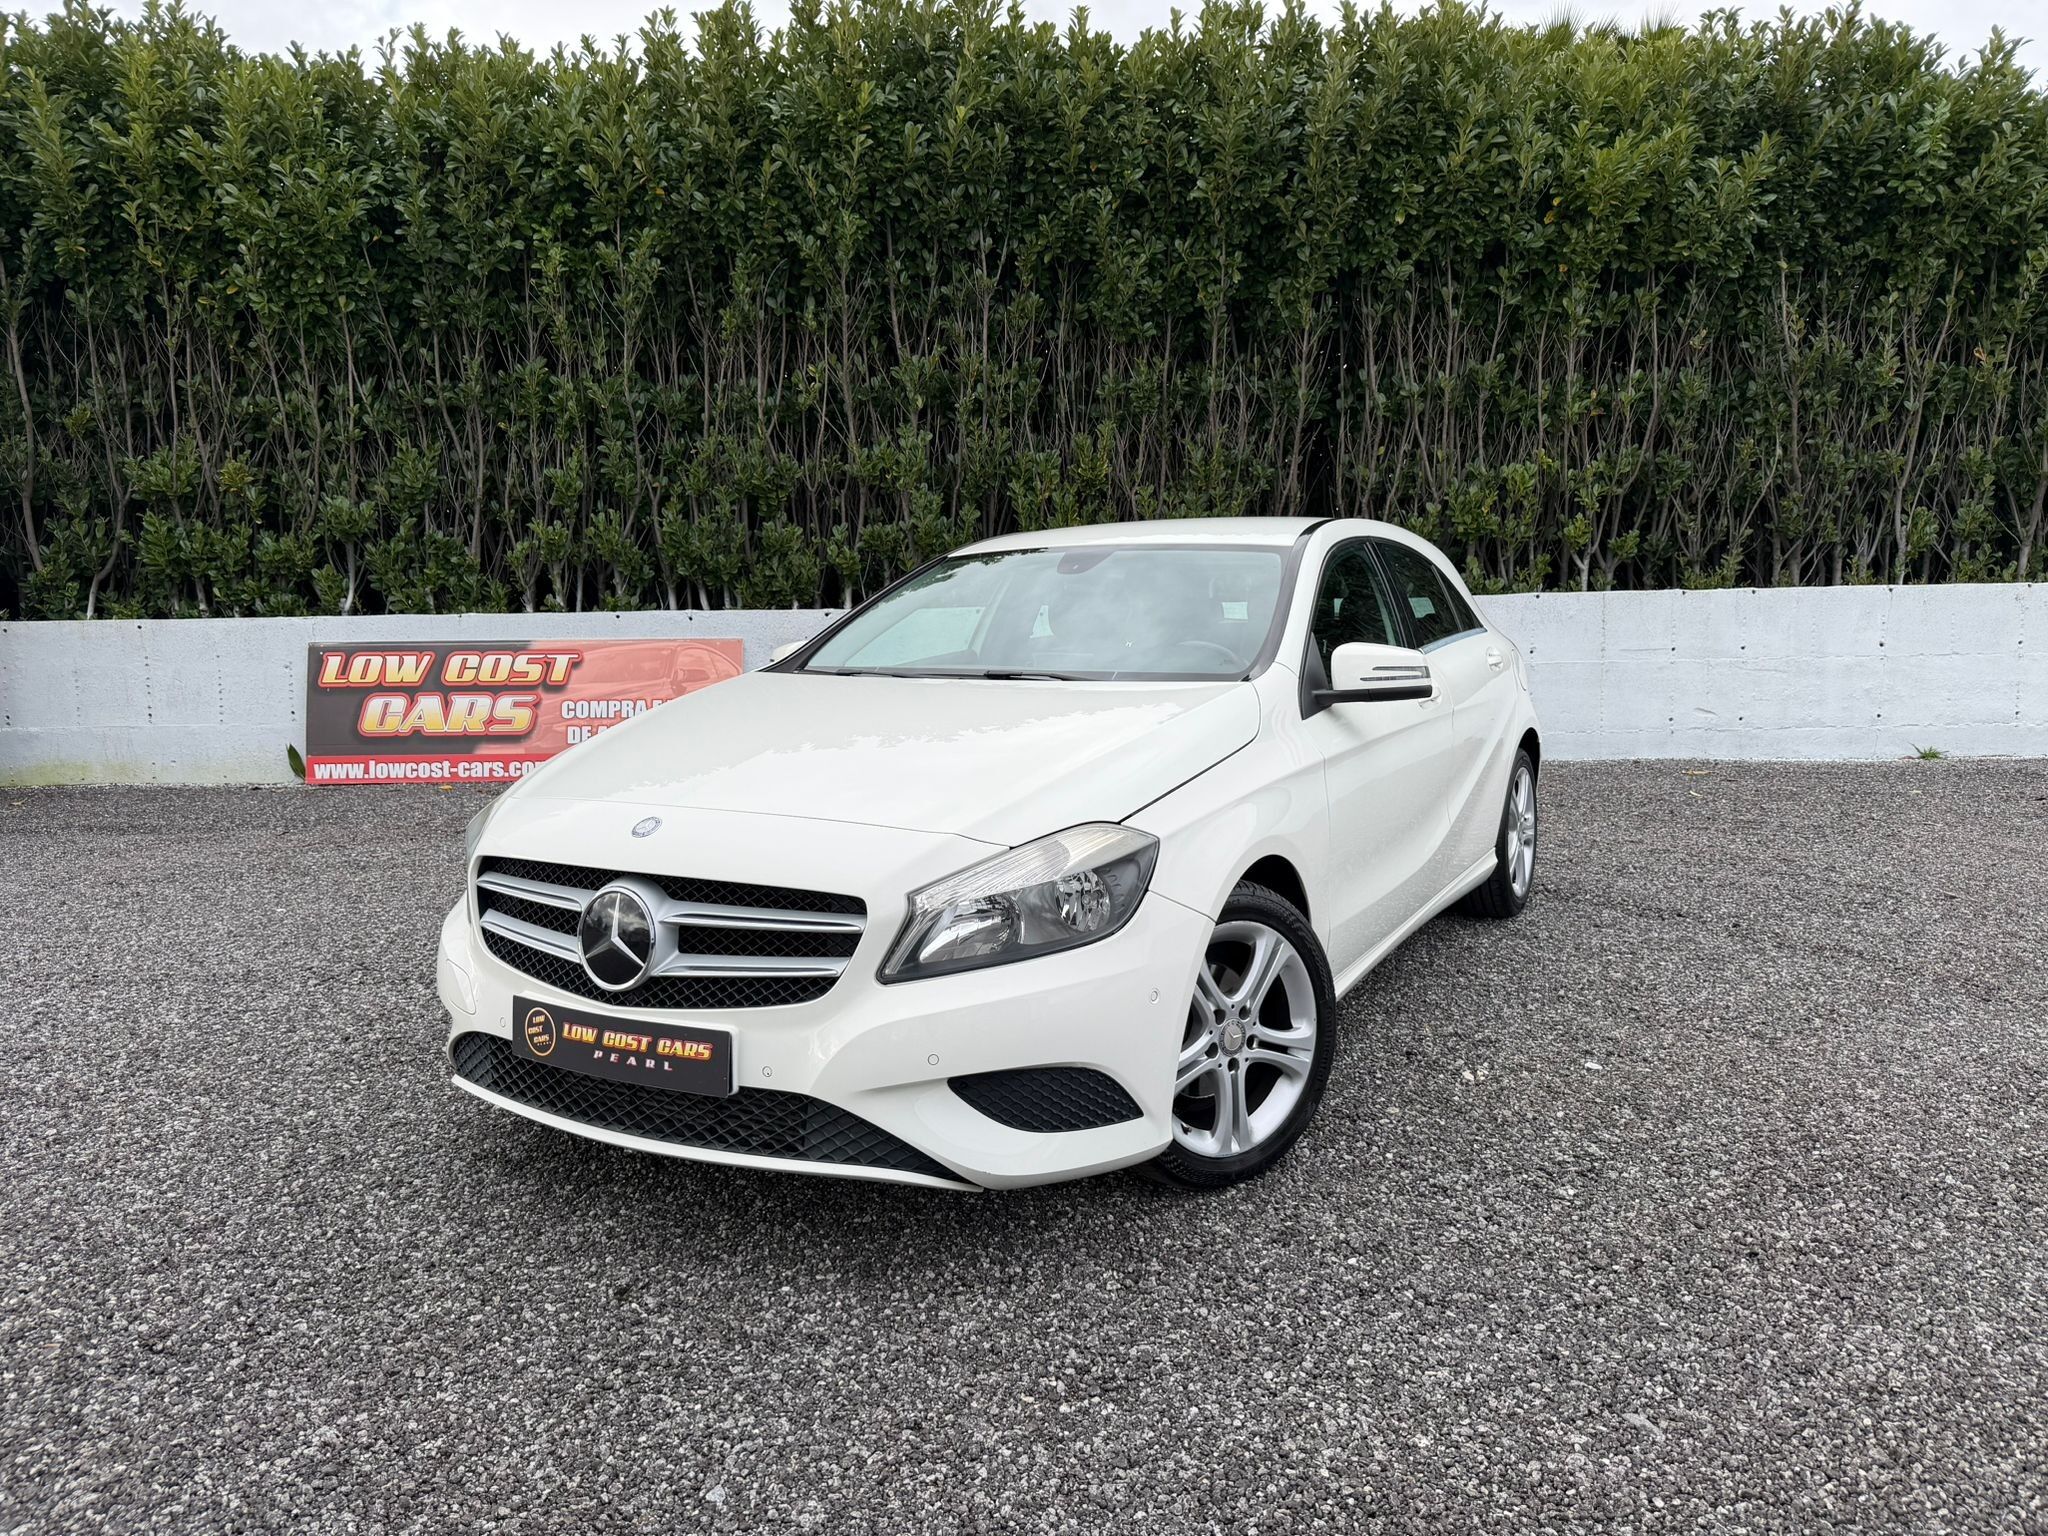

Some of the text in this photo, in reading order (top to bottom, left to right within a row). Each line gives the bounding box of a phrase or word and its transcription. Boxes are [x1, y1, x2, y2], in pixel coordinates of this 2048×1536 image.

[319, 651, 581, 686] LOW COST
[358, 692, 540, 736] CARS
[561, 699, 648, 719] COMPRA
[313, 760, 546, 779] www.lowcost-cars.co
[562, 1022, 713, 1061] LOW COST CARS
[593, 1050, 673, 1071] PEARL
